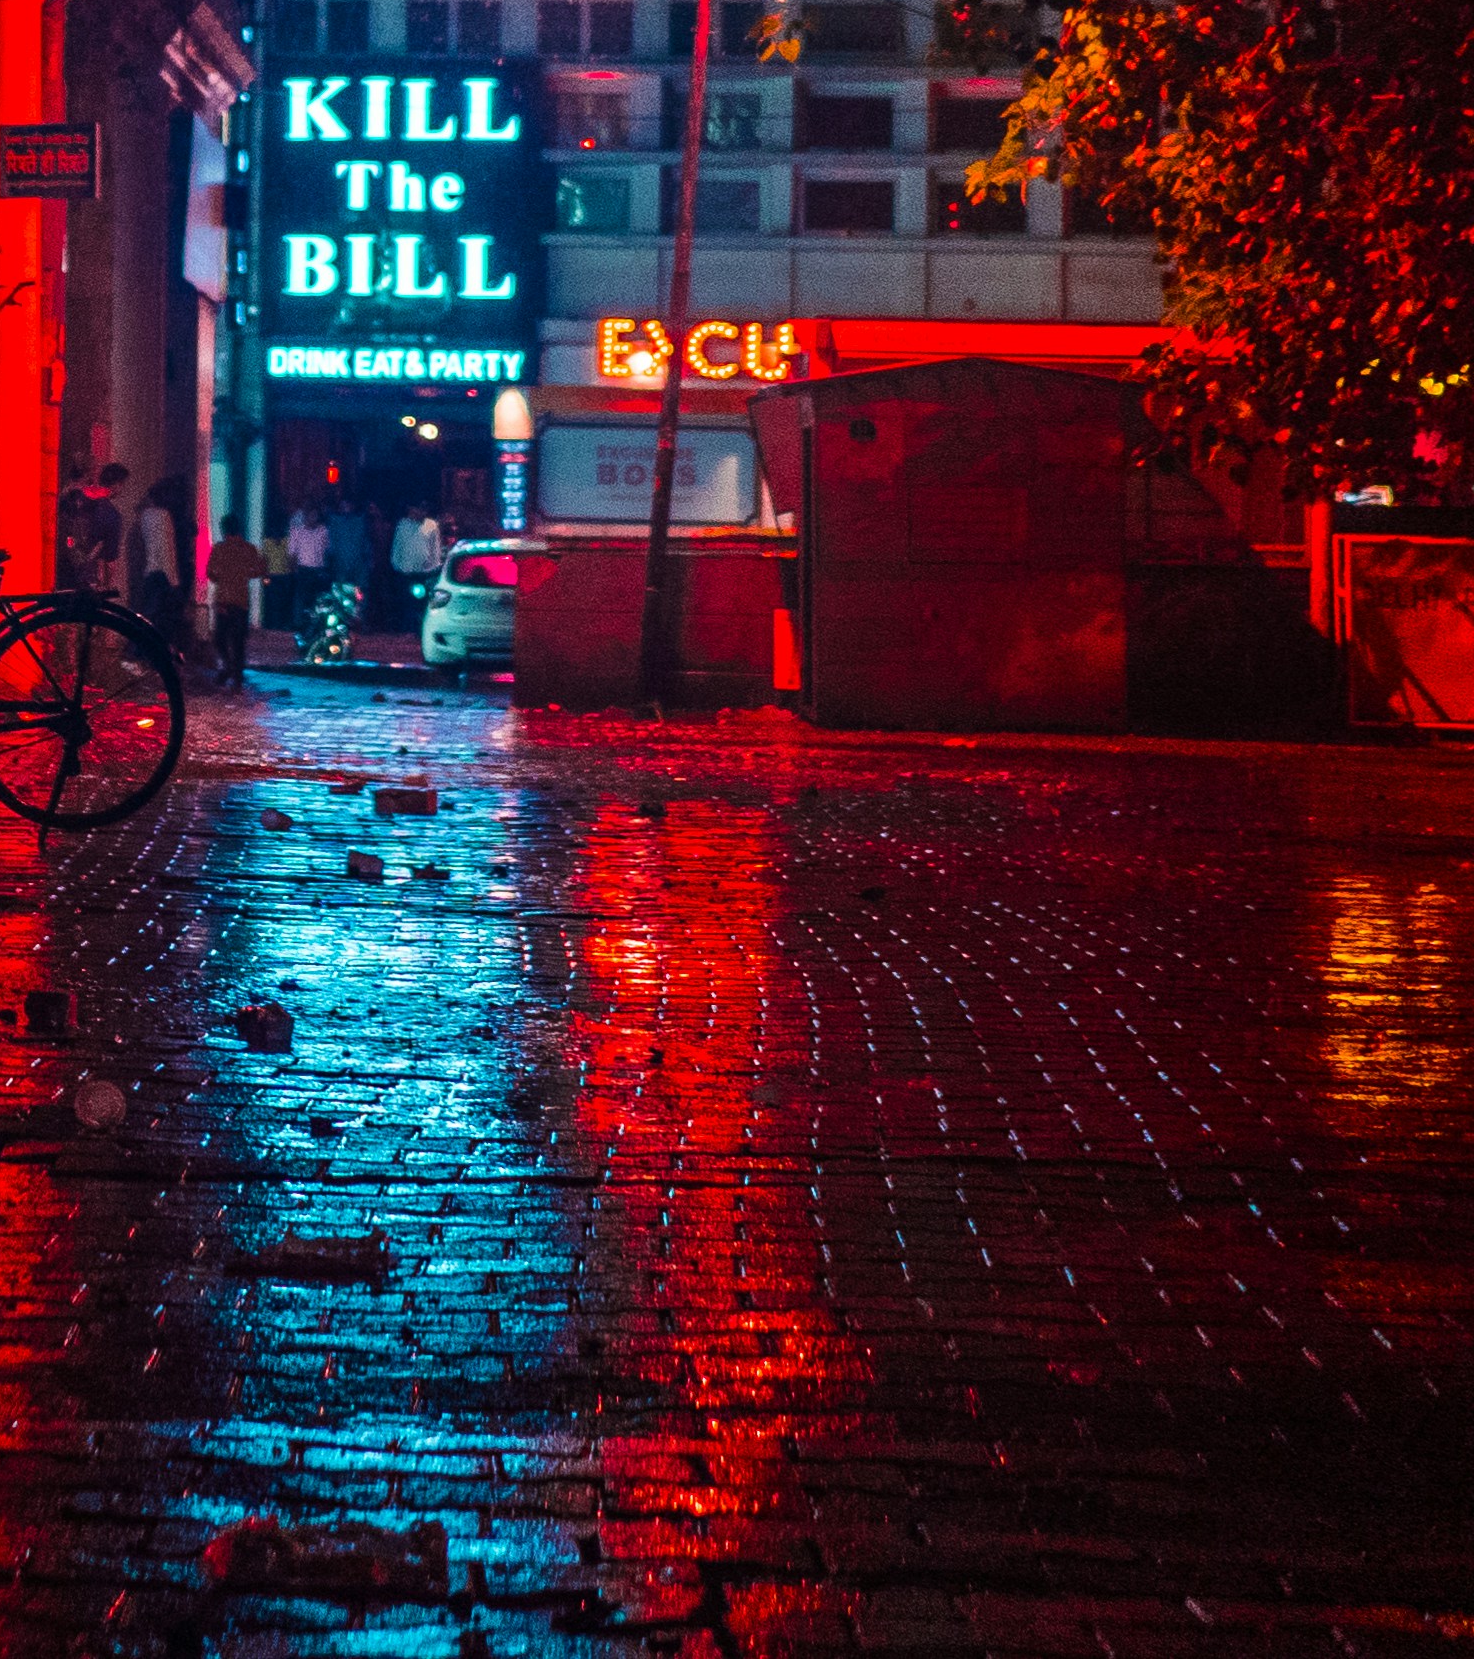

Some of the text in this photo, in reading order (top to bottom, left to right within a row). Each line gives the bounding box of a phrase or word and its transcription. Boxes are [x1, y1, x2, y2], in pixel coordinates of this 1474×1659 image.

[284, 77, 521, 141] KILL
[336, 160, 465, 212] The
[283, 235, 516, 299] BILL
[268, 346, 349, 378] DRINK
[428, 349, 525, 381] PARTY
[597, 463, 696, 487] BOS
